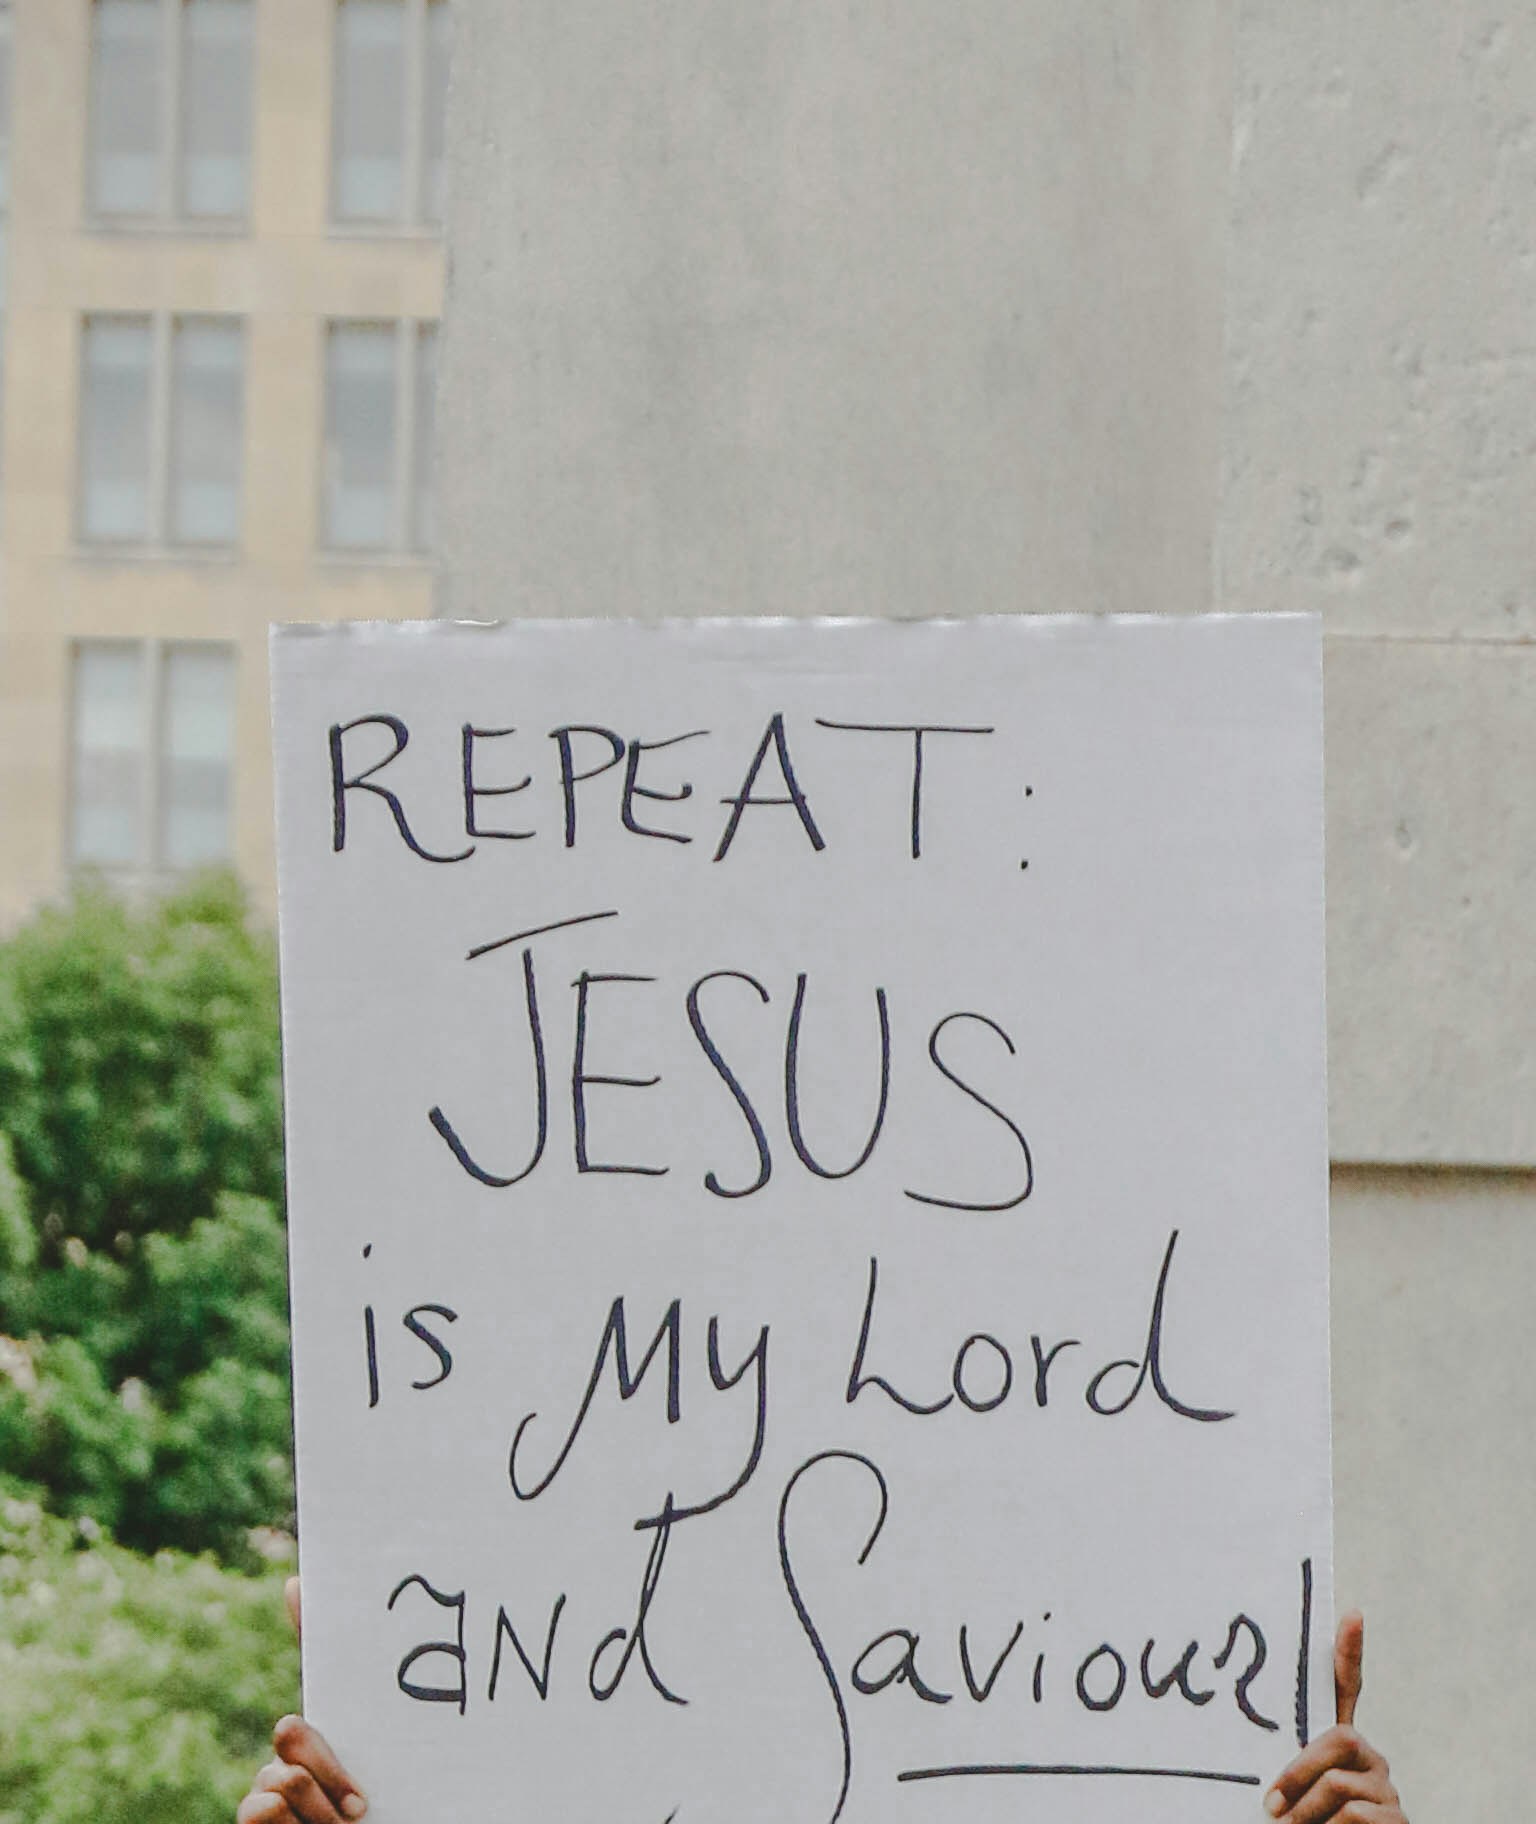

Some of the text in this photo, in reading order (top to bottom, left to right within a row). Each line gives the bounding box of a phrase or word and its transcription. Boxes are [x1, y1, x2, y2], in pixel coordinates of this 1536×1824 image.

[328, 711, 1036, 872] REPEAT:
[429, 910, 1034, 1212] JESUS
[363, 1230, 1236, 1532] is My Lord
